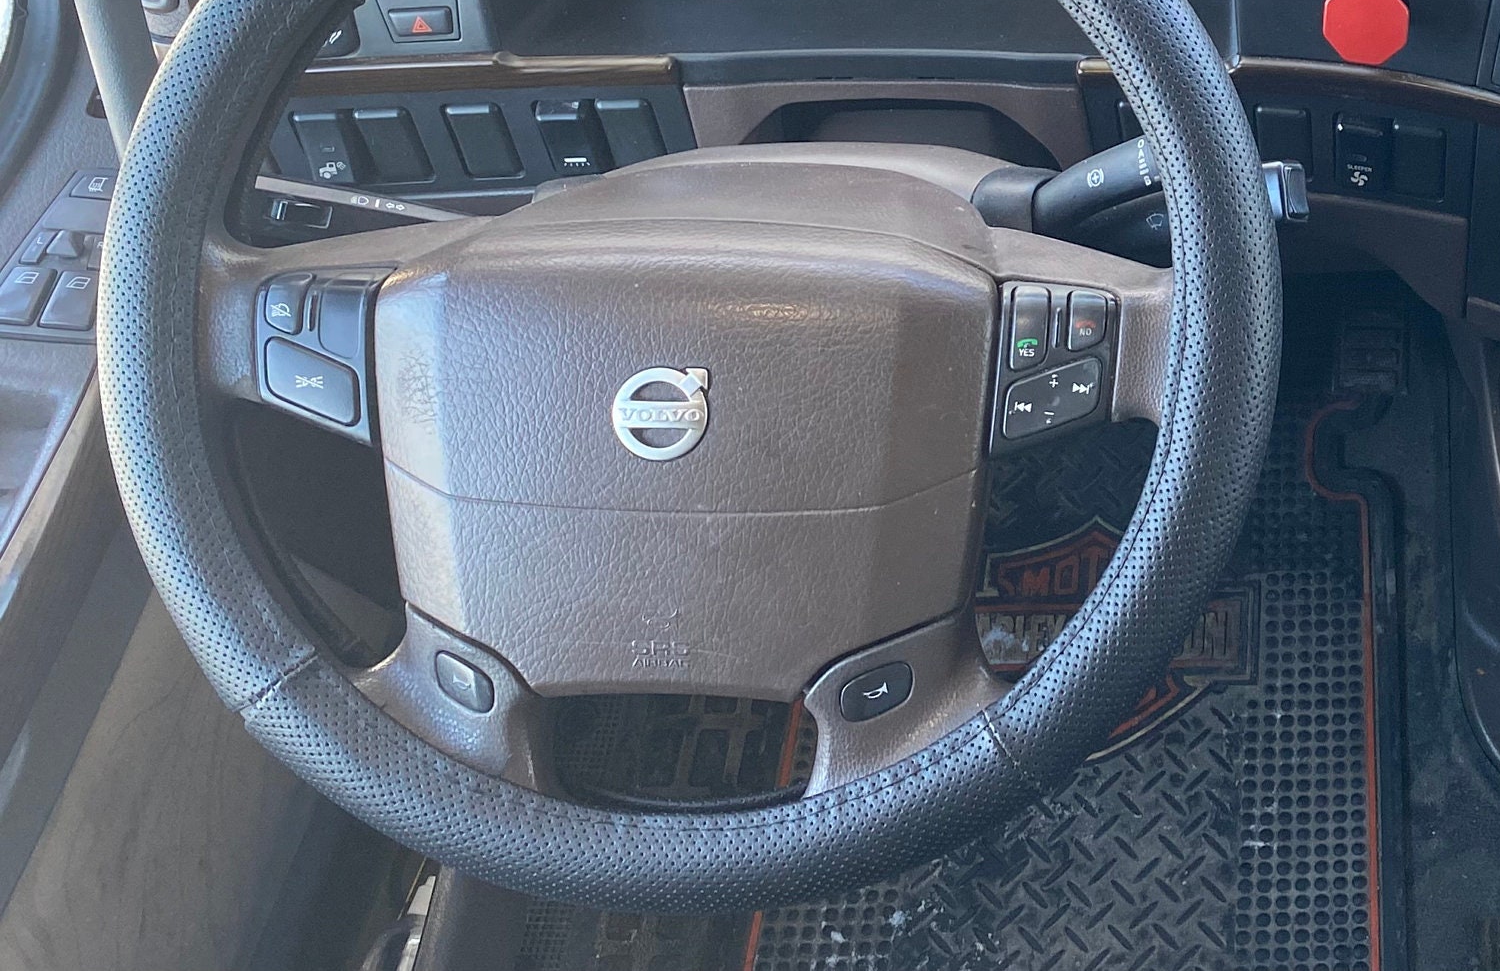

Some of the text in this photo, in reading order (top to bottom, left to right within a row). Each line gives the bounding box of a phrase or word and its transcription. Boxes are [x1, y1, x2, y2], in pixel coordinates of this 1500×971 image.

[1080, 328, 1091, 336] NO
[1019, 349, 1035, 357] YES
[620, 408, 704, 421] VOLVO
[632, 640, 690, 656] SRS
